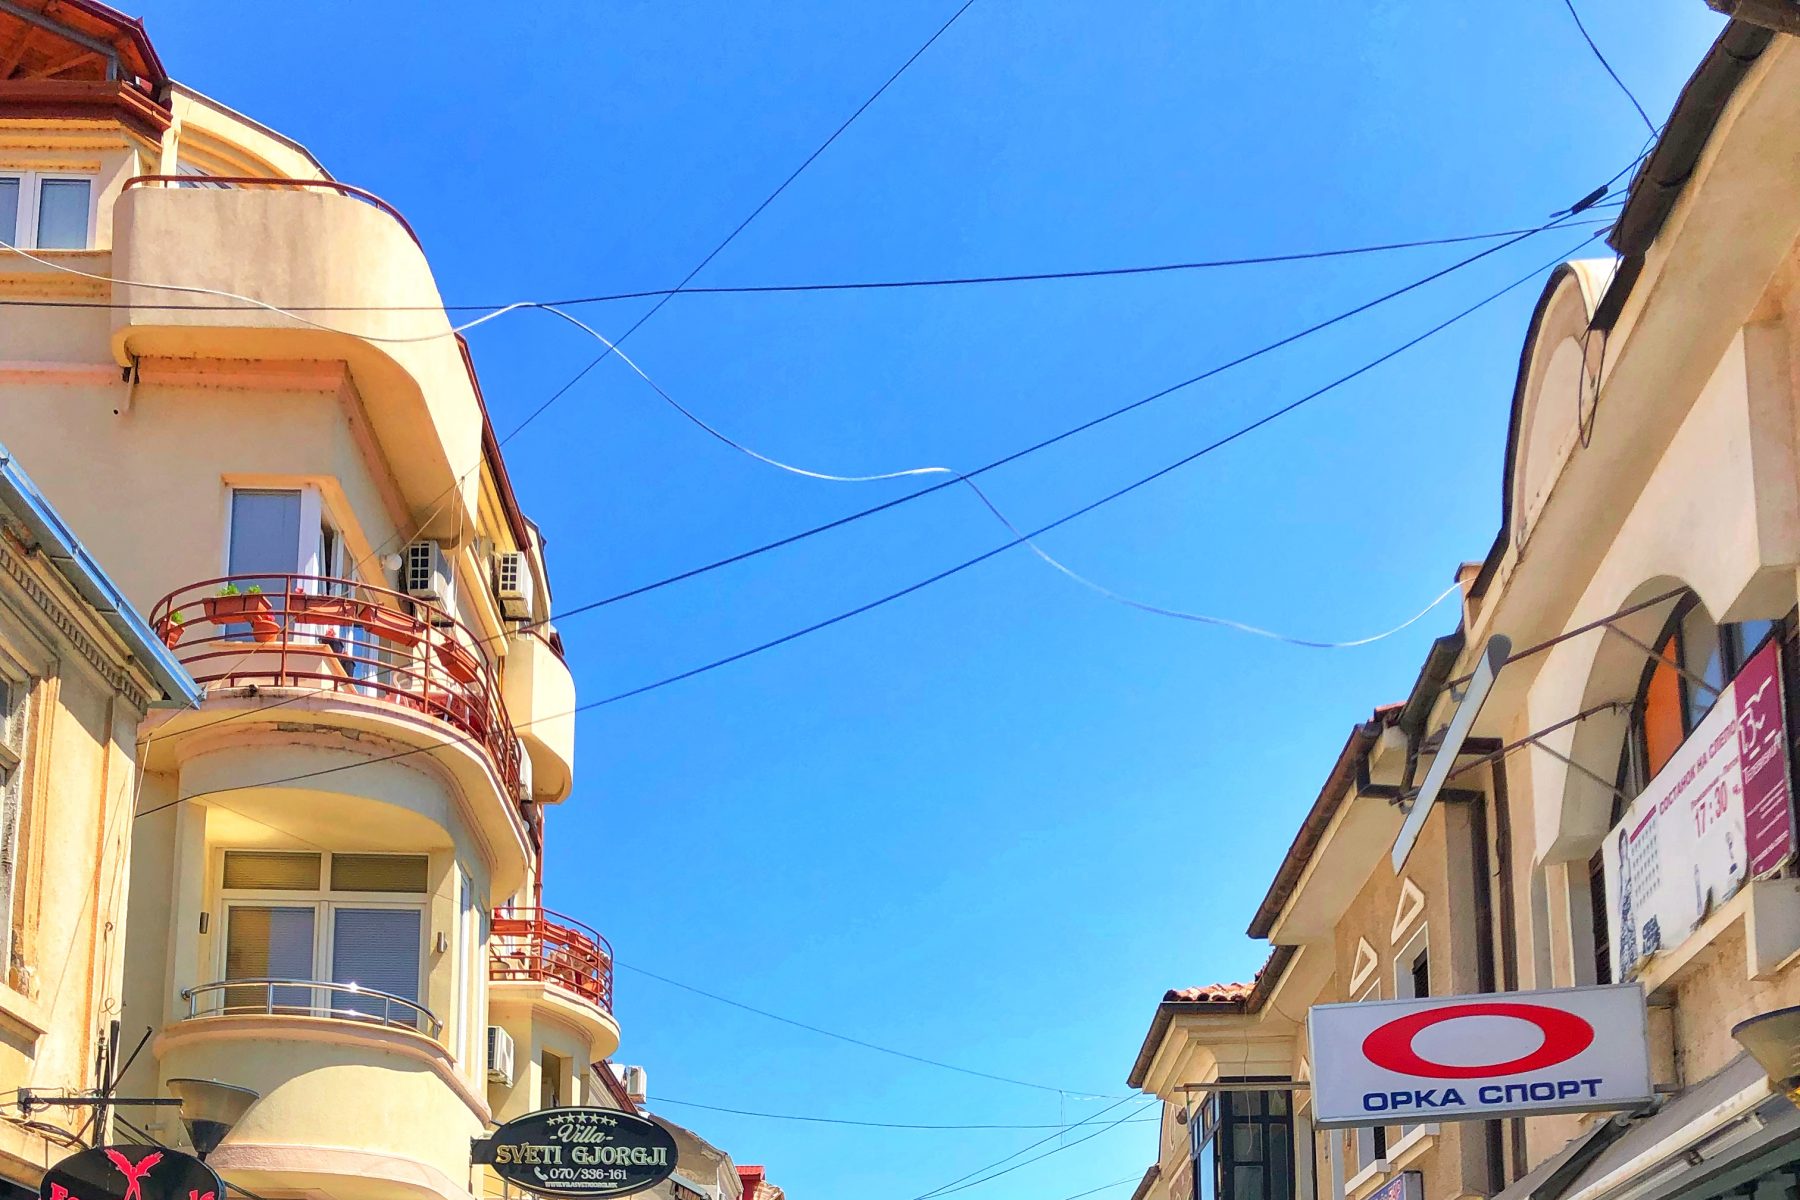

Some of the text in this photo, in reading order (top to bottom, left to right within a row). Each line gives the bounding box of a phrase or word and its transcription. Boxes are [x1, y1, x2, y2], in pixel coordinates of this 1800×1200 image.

[1363, 1079, 1603, 1111] ОРКА СПОРТ
[495, 1143, 667, 1166] SVETI GJORGJI
